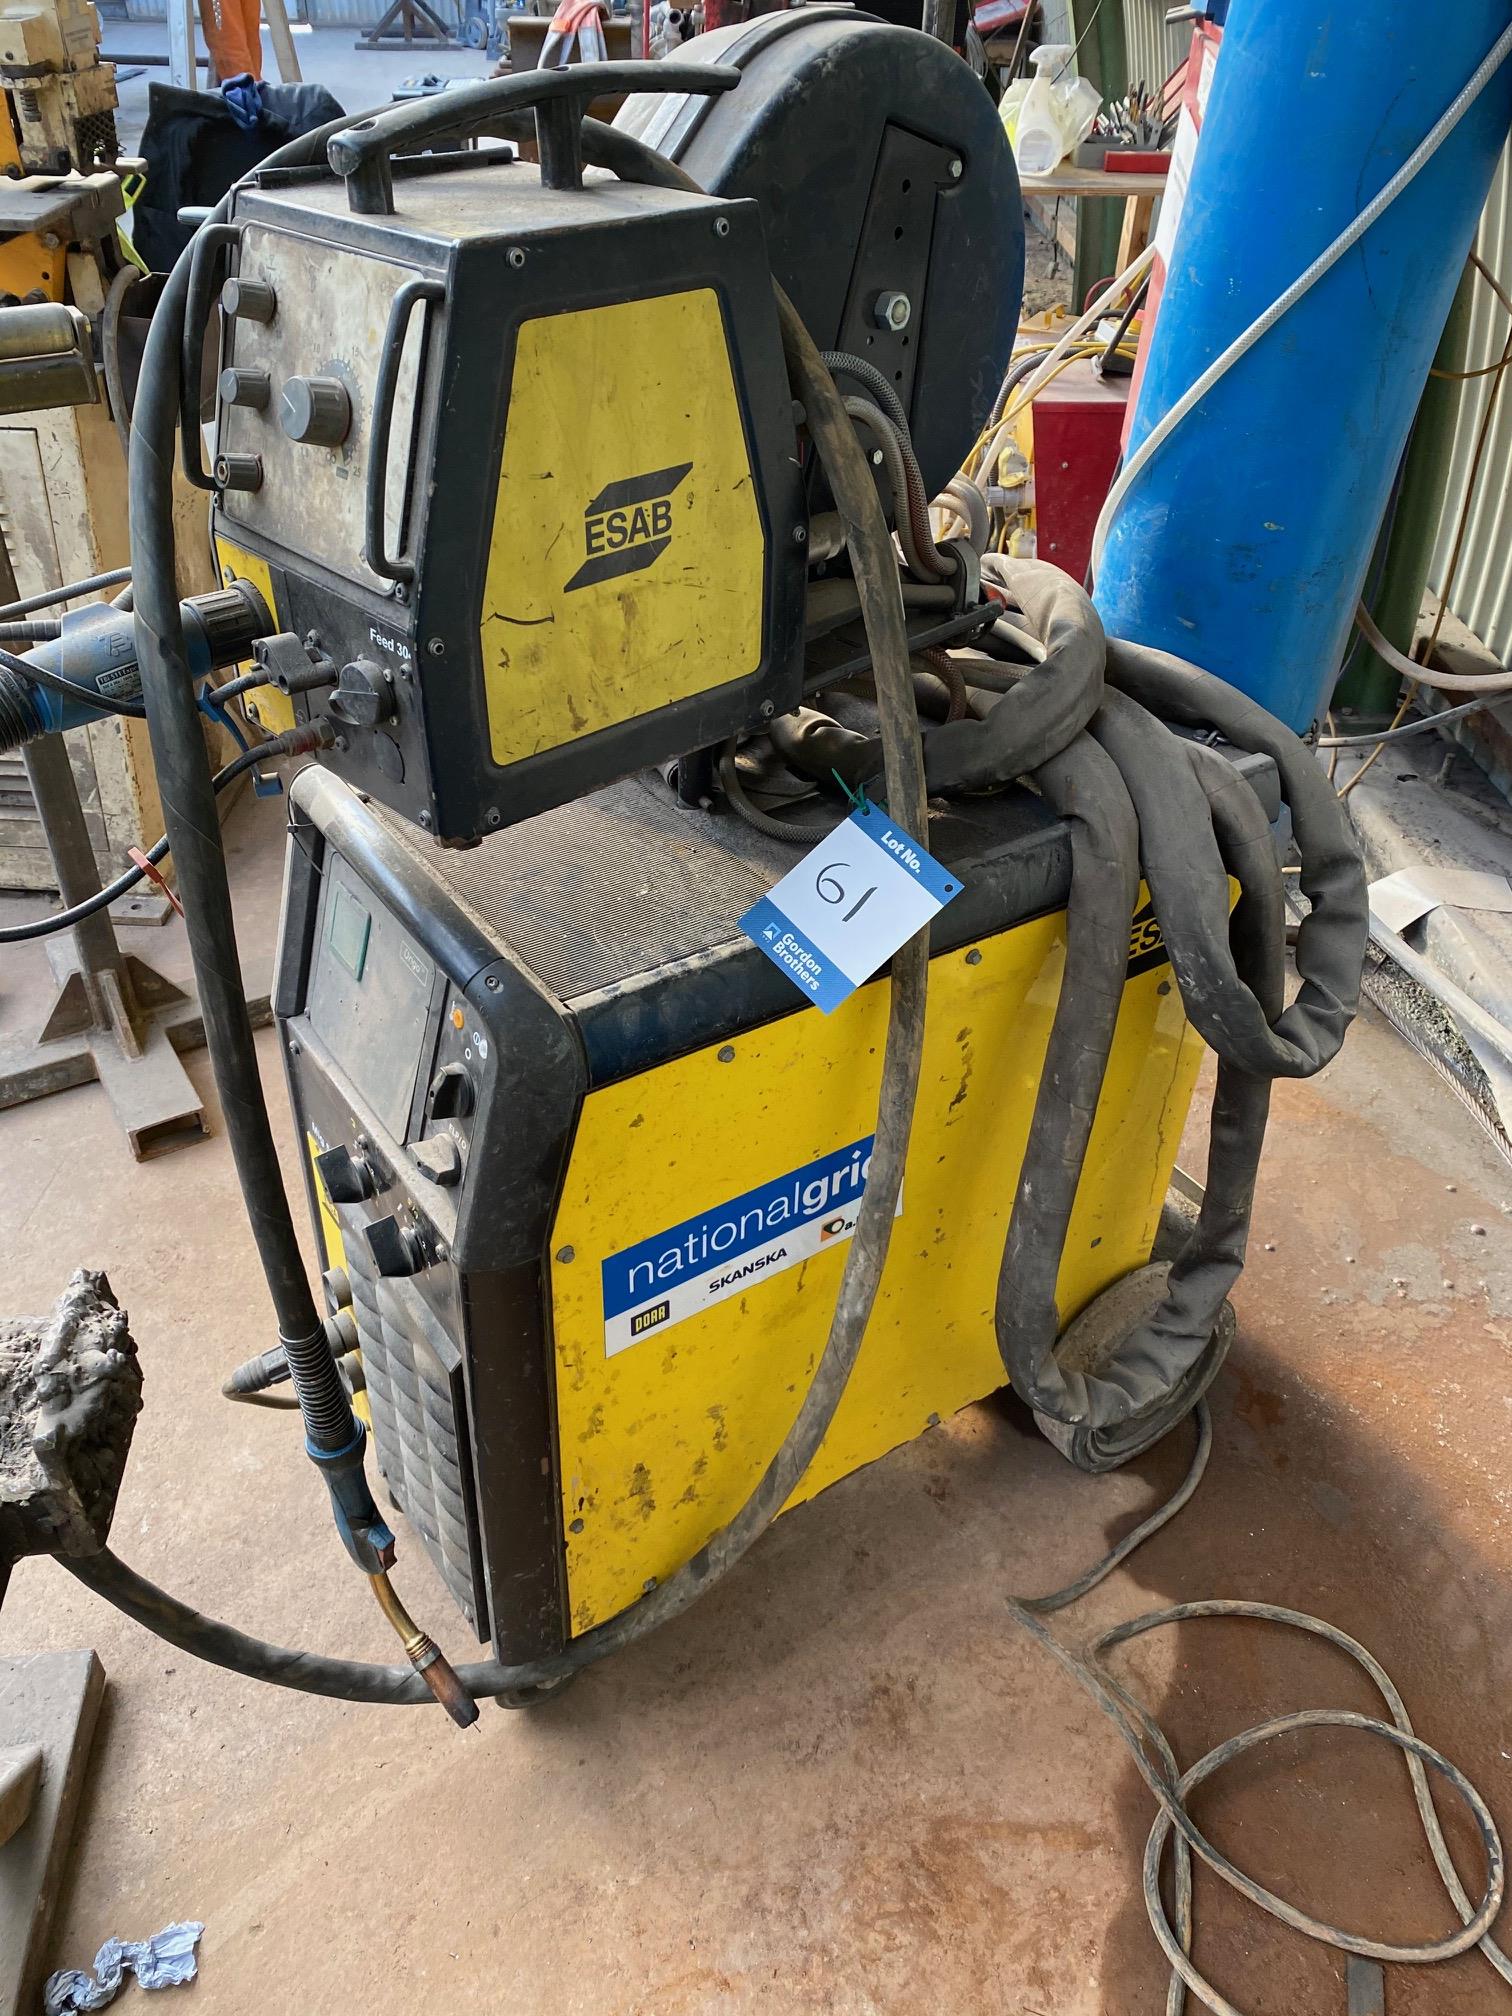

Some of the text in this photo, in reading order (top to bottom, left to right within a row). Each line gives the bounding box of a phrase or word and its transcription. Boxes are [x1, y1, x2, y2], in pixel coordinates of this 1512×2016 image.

[585, 500, 672, 555] ESAB
[370, 627, 395, 652] Feed
[880, 830, 921, 874] Lot No.
[815, 862, 878, 923] 61
[781, 933, 822, 976] Gordon
[1128, 920, 1163, 957] ES
[772, 942, 820, 991] Brothers
[708, 1247, 788, 1294] SKANSKA
